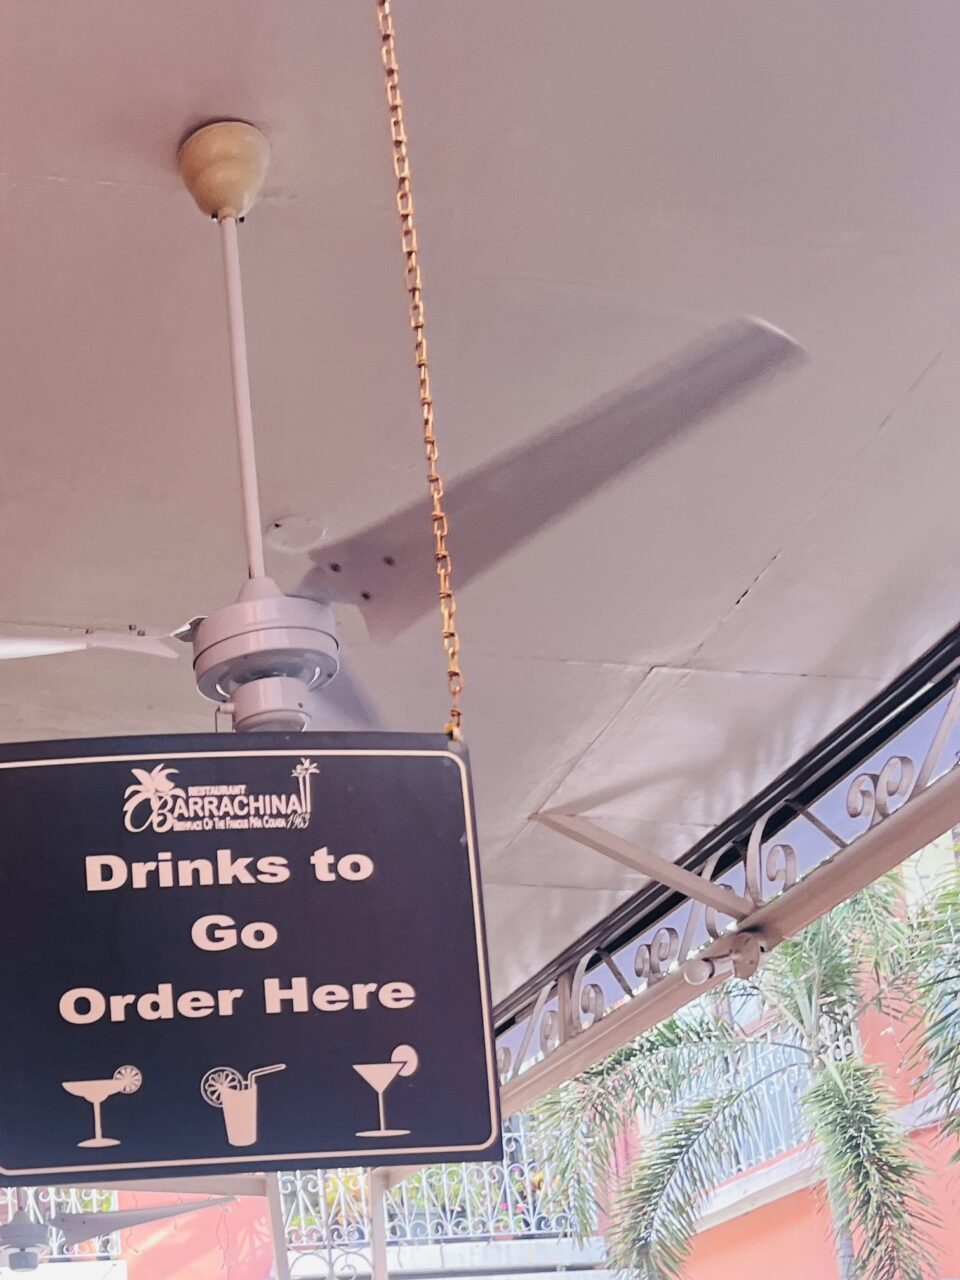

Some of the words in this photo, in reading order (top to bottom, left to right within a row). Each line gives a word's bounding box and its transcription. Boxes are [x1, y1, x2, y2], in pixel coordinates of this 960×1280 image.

[188, 785, 246, 796] RESTAURANT
[124, 794, 303, 832] BARRACHINA
[85, 849, 291, 891] Drinks
[310, 847, 374, 882] to
[191, 914, 278, 951] Go
[58, 983, 243, 1024] Order
[264, 977, 416, 1014] Here
